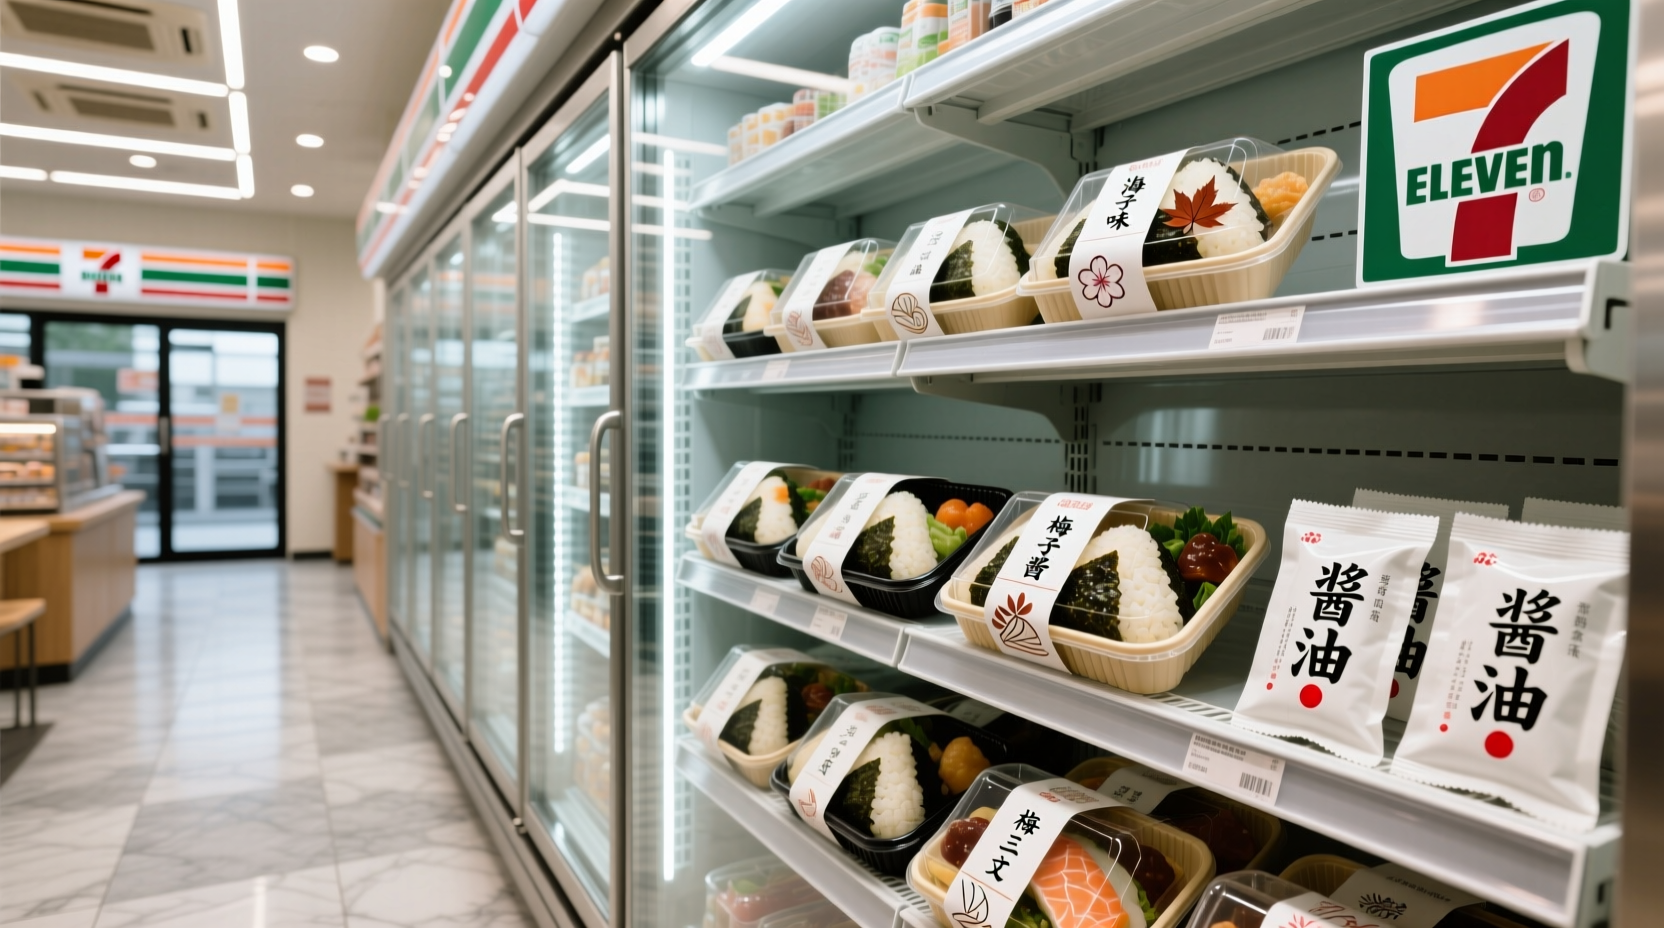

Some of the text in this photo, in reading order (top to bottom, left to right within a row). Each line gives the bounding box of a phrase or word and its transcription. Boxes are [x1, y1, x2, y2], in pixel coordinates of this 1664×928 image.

[1414, 38, 1569, 262] 7
[1291, 562, 1369, 685] 酱油
[1470, 588, 1562, 732] 酱油
